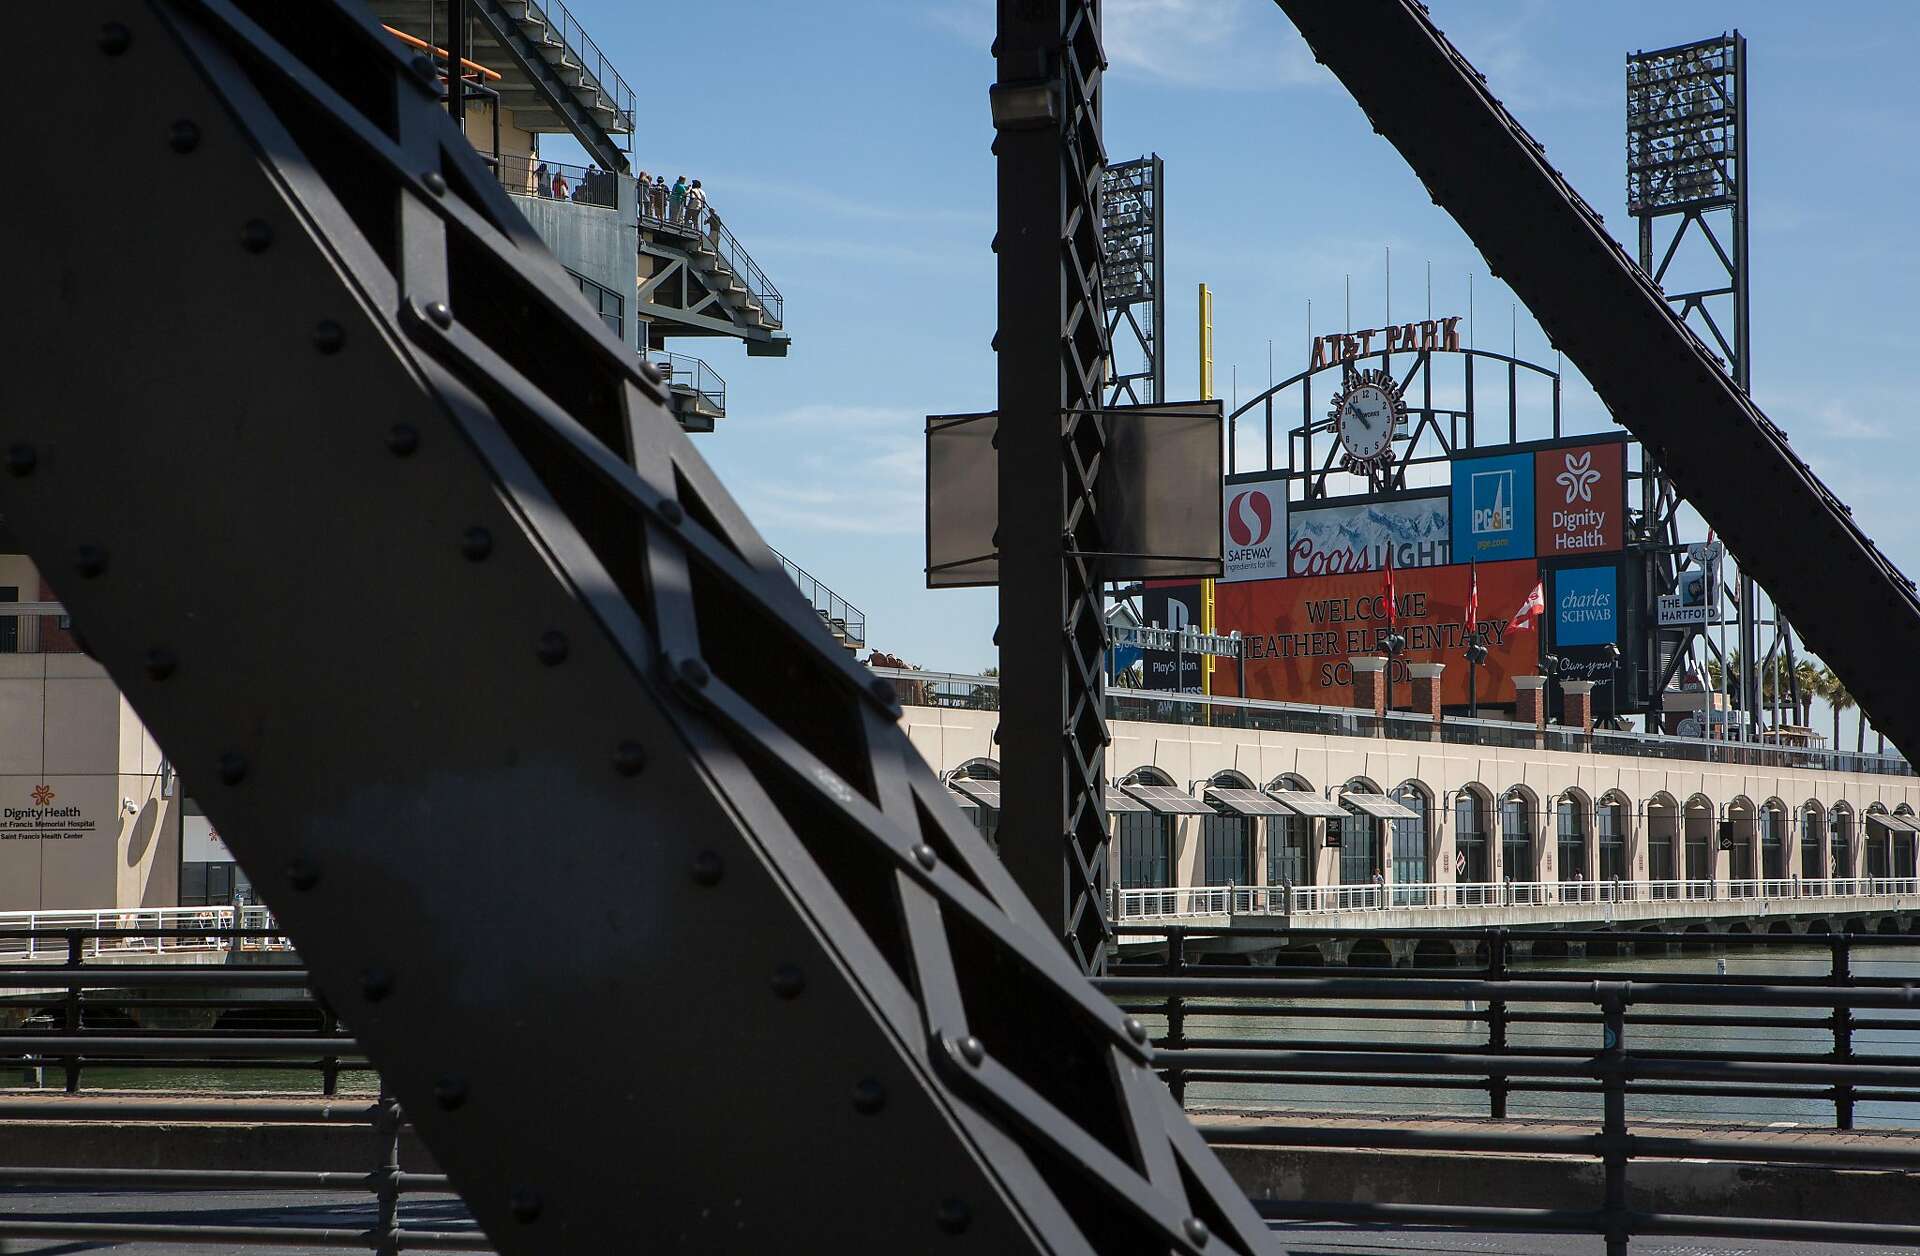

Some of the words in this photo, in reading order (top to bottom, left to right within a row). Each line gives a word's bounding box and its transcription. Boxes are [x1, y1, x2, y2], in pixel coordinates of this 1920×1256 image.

[1311, 328, 1375, 372] AT&T
[1385, 316, 1463, 352] PARK
[1353, 395, 1359, 404] 11
[1362, 390, 1370, 399] 12
[1375, 392, 1379, 401] 1
[1345, 407, 1351, 415] 10
[1382, 401, 1387, 410] 2
[1474, 507, 1512, 530] PG&E
[1552, 508, 1606, 530] Dignity
[1555, 530, 1604, 549] Health
[1228, 546, 1272, 562] SAFEWAY
[1289, 538, 1372, 577] Coors
[1561, 588, 1611, 609] charles
[1661, 599, 1680, 609] THE
[1305, 592, 1427, 623] WELCOME
[1561, 608, 1612, 623] SCHWAB
[1152, 660, 1197, 675] PlayStion
[1321, 660, 1414, 687] SCOL
[4, 808, 42, 820] Dignity
[44, 806, 81, 817] Health
[9, 820, 33, 828] Francis
[35, 820, 66, 828] Memorial
[67, 820, 95, 829] Hospital
